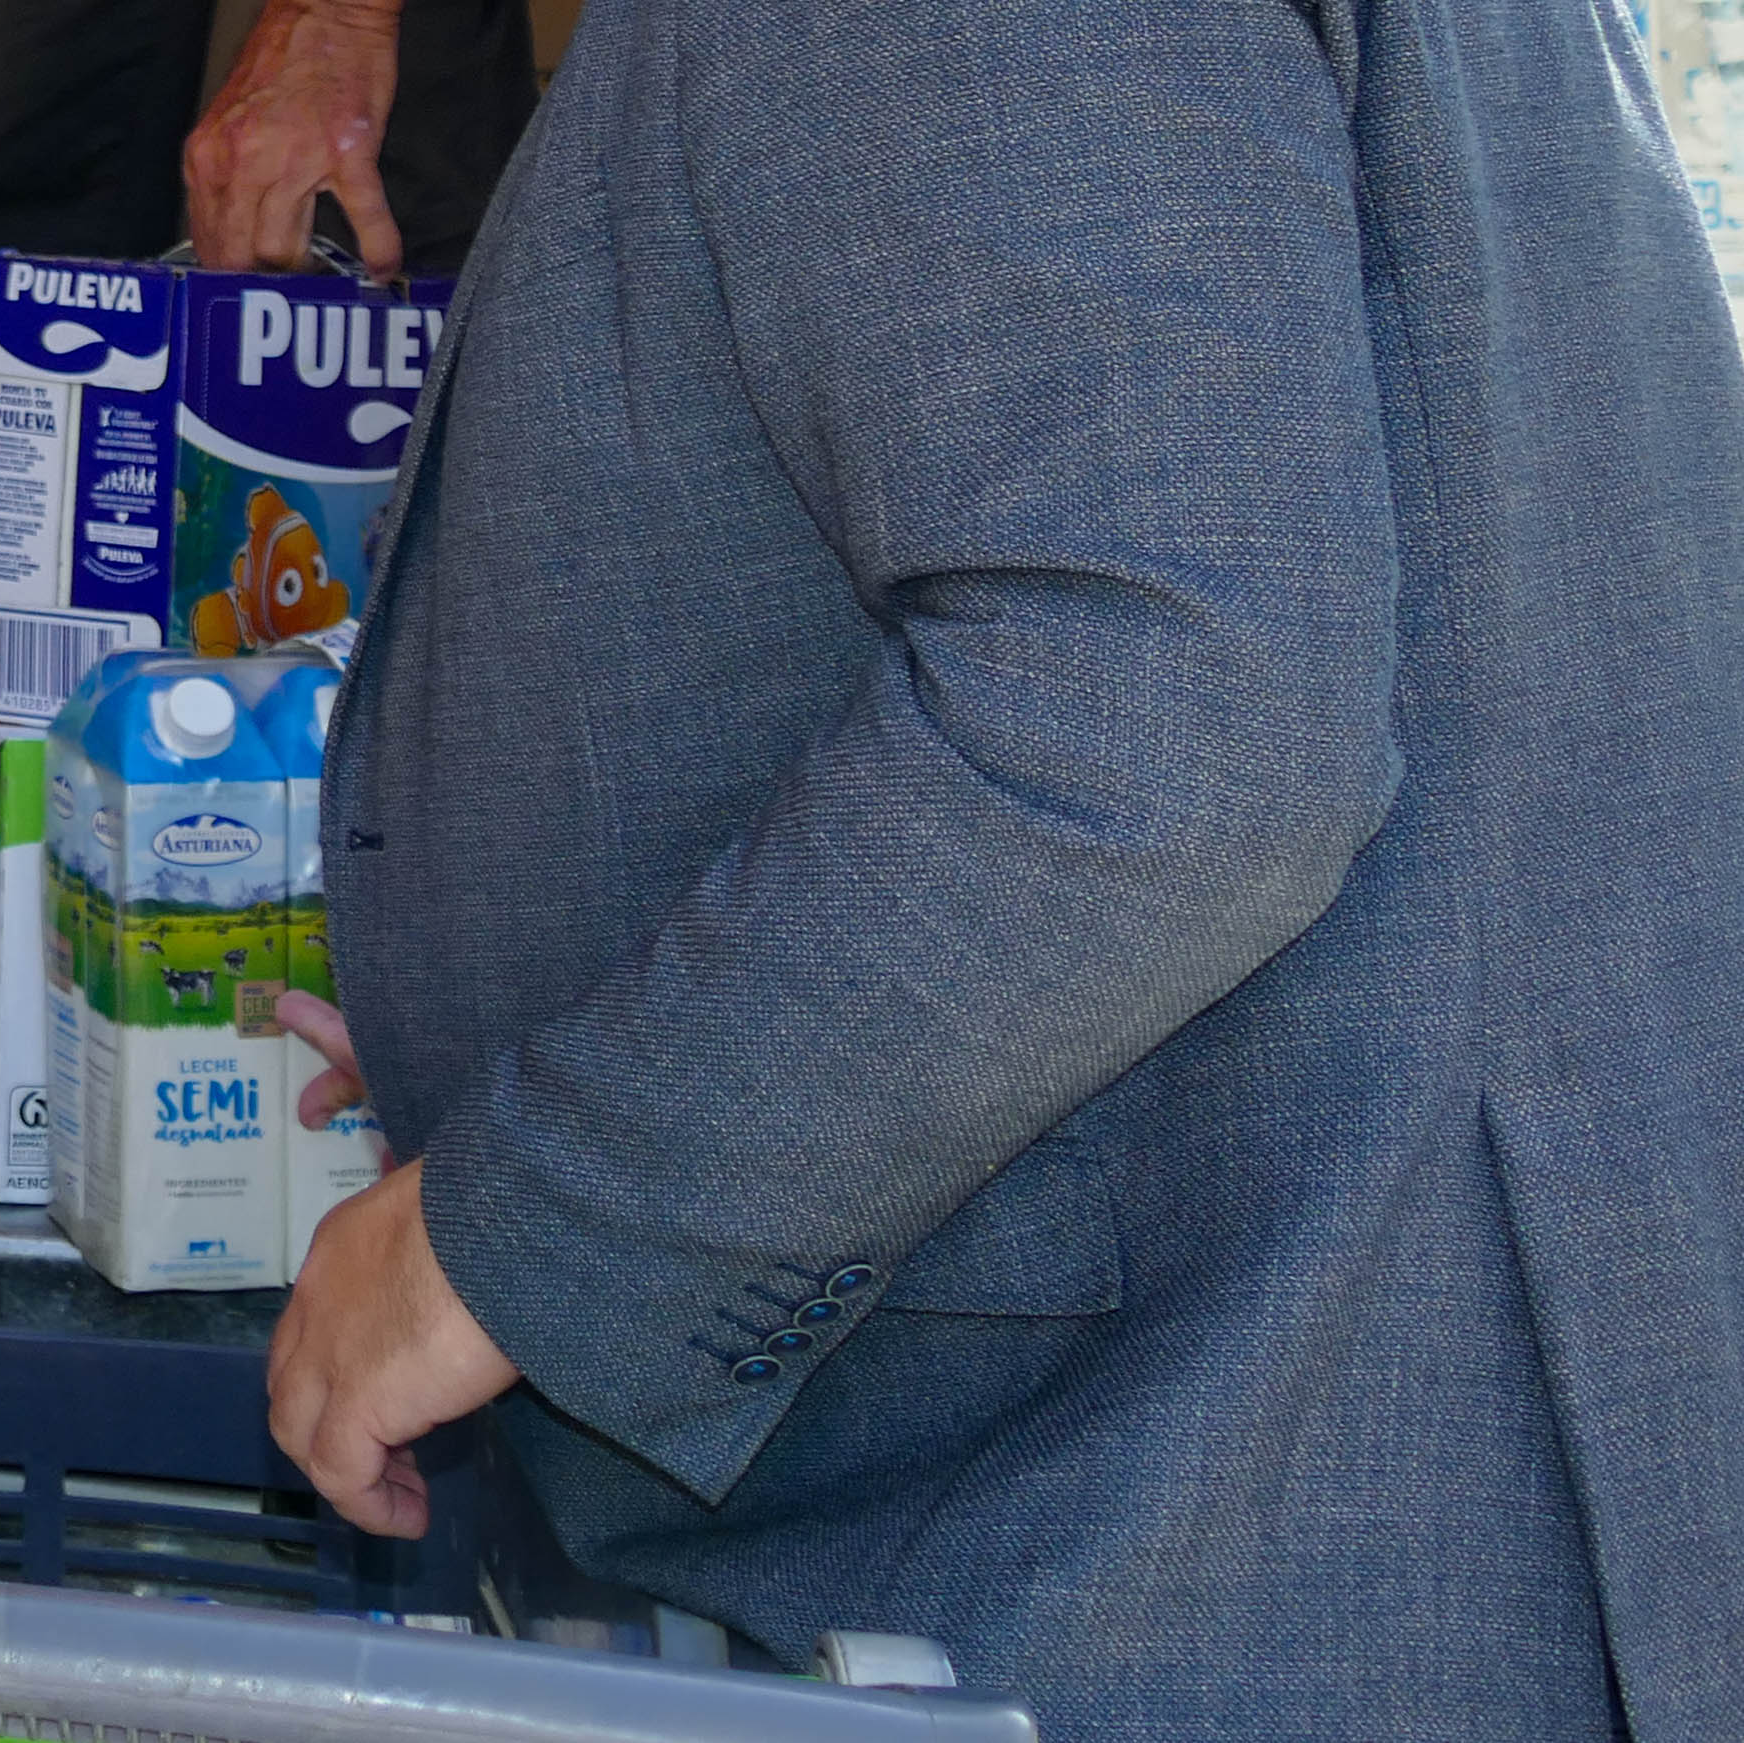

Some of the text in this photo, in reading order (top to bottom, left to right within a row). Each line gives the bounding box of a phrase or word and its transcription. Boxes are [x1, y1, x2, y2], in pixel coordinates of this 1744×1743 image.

[5, 261, 144, 313] PULEVA
[161, 834, 253, 854] ASTURIANA
[180, 1059, 239, 1075] LECHE
[154, 1121, 264, 1147] desnatada
